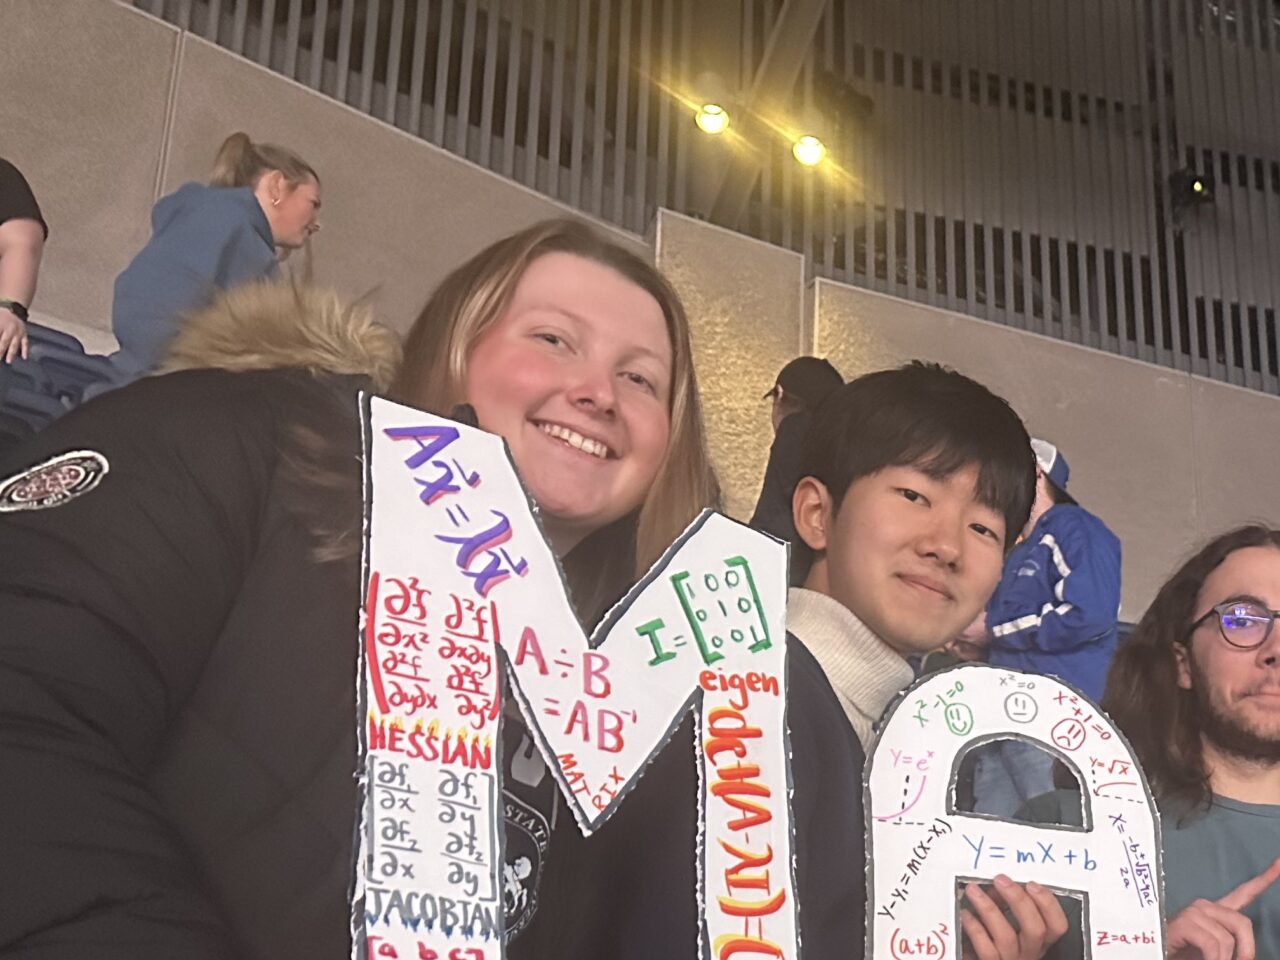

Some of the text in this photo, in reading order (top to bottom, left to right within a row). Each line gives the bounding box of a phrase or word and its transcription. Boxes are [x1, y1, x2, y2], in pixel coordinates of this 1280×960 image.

[698, 668, 780, 711] eigen
[369, 713, 493, 770] HESSIAN
[504, 804, 548, 852] STATE
[365, 887, 499, 941] JACOBIAN
